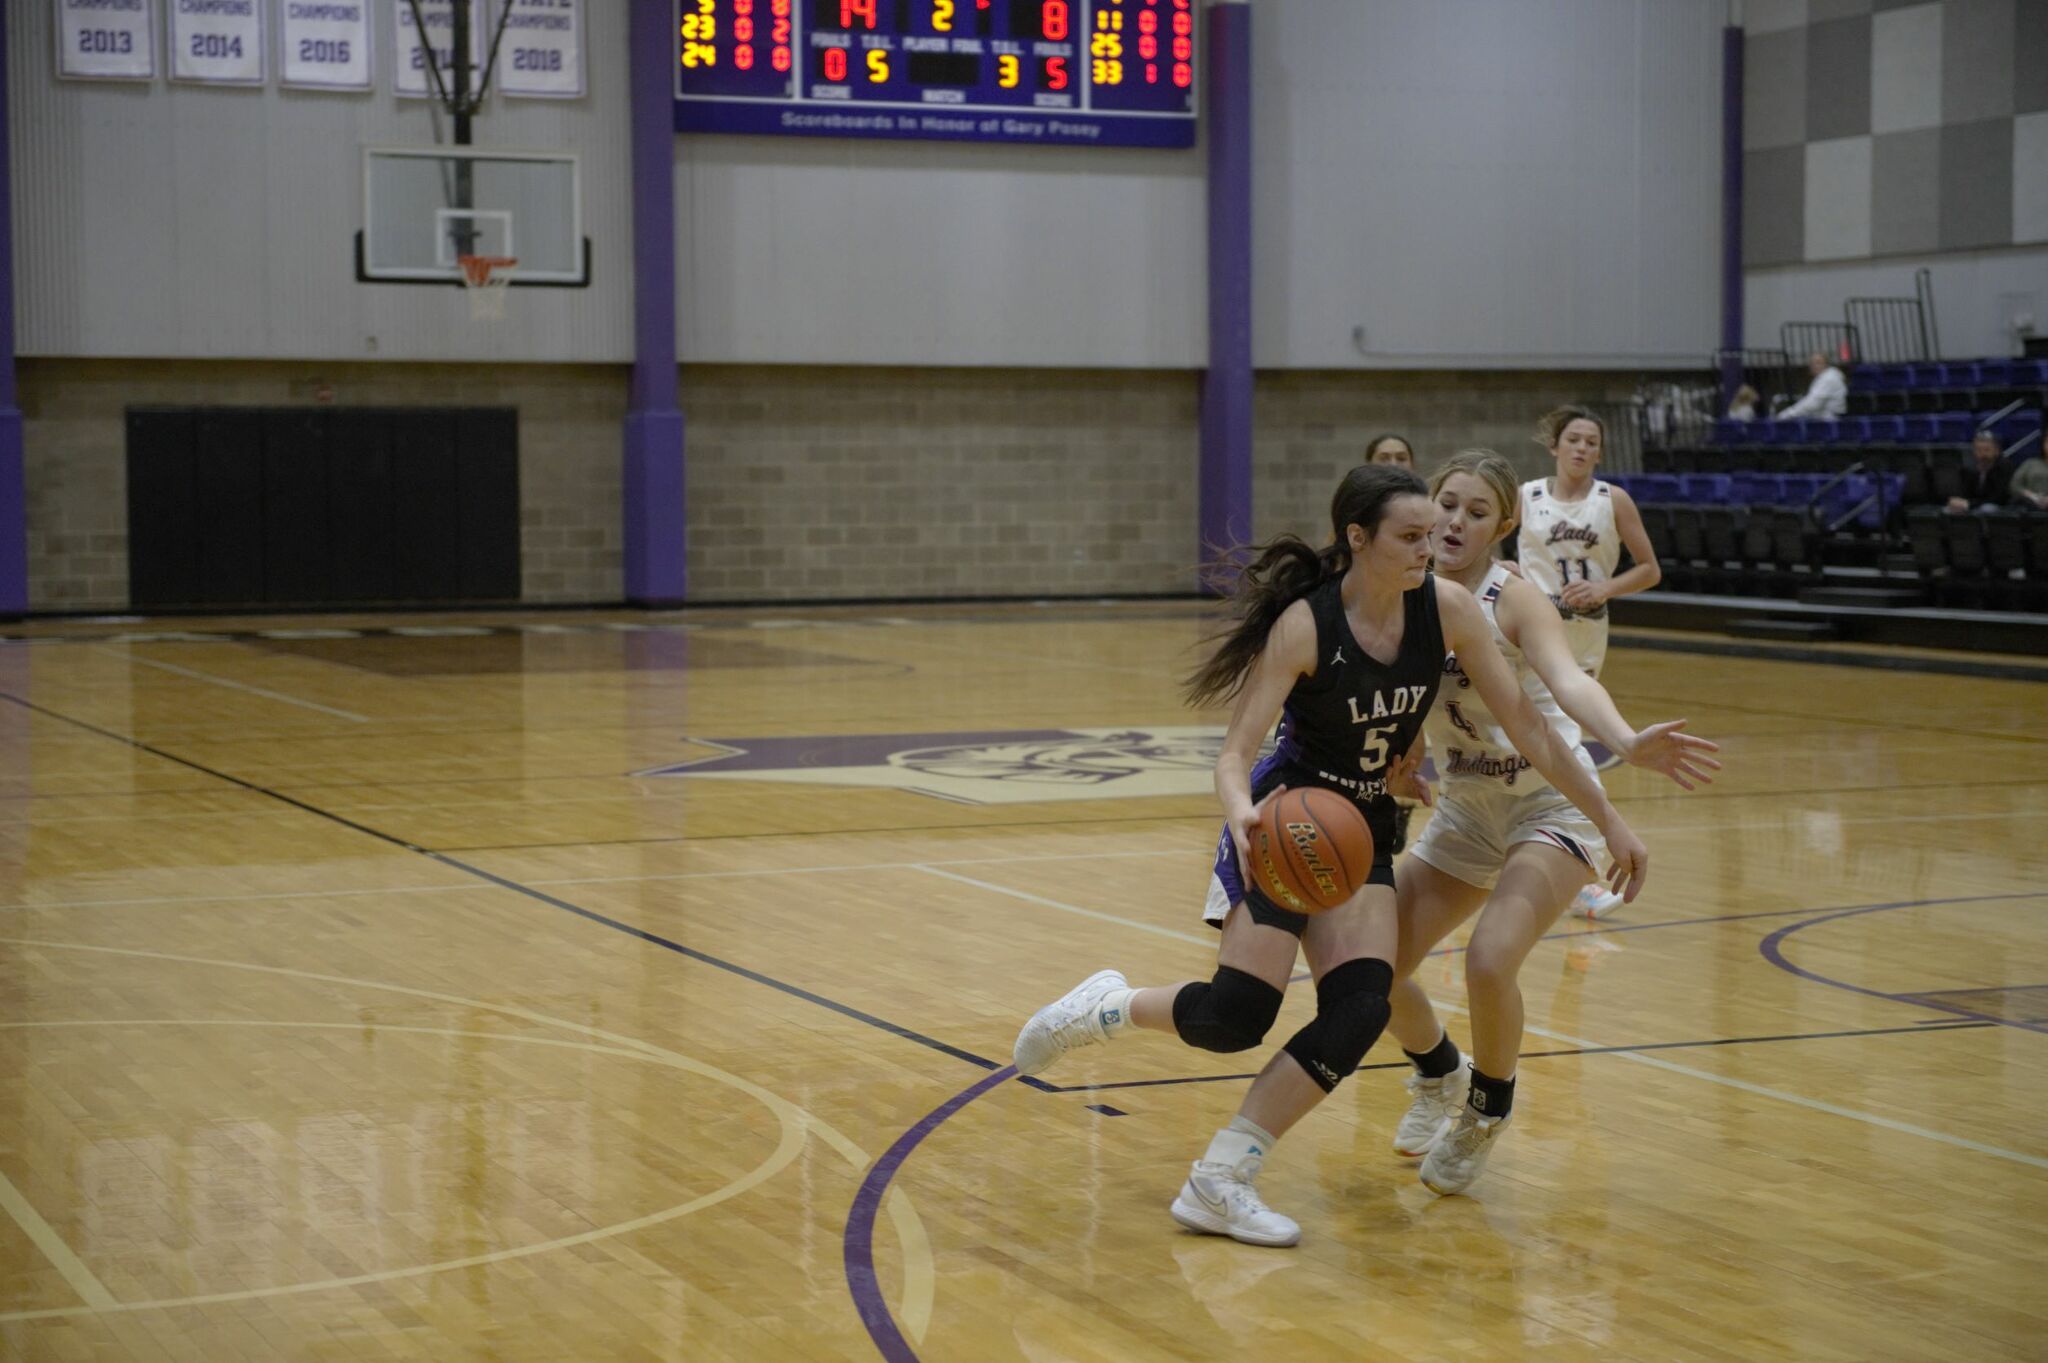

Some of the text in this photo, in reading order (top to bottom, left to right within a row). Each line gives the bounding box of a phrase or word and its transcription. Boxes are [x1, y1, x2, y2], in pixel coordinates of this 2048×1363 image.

[681, 13, 716, 40] 23
[79, 28, 132, 54] 2013
[191, 33, 243, 58] 2014
[299, 39, 350, 63] 2016
[682, 41, 716, 68] 24
[1090, 32, 1123, 58] 25
[513, 48, 562, 71] 2018
[824, 47, 847, 81] 0
[866, 49, 890, 83] 5
[998, 54, 1019, 88] 3
[1045, 56, 1068, 90] 5
[1092, 58, 1123, 85] 33
[781, 112, 893, 129] Scoreboards
[921, 116, 975, 131] Honor
[980, 119, 999, 132] of
[1002, 119, 1044, 136] Gary
[1049, 121, 1101, 137] Posey
[1546, 520, 1600, 549] Lady
[1347, 686, 1427, 724] LADY
[1359, 723, 1399, 772] 5
[1286, 823, 1338, 896] Baden
